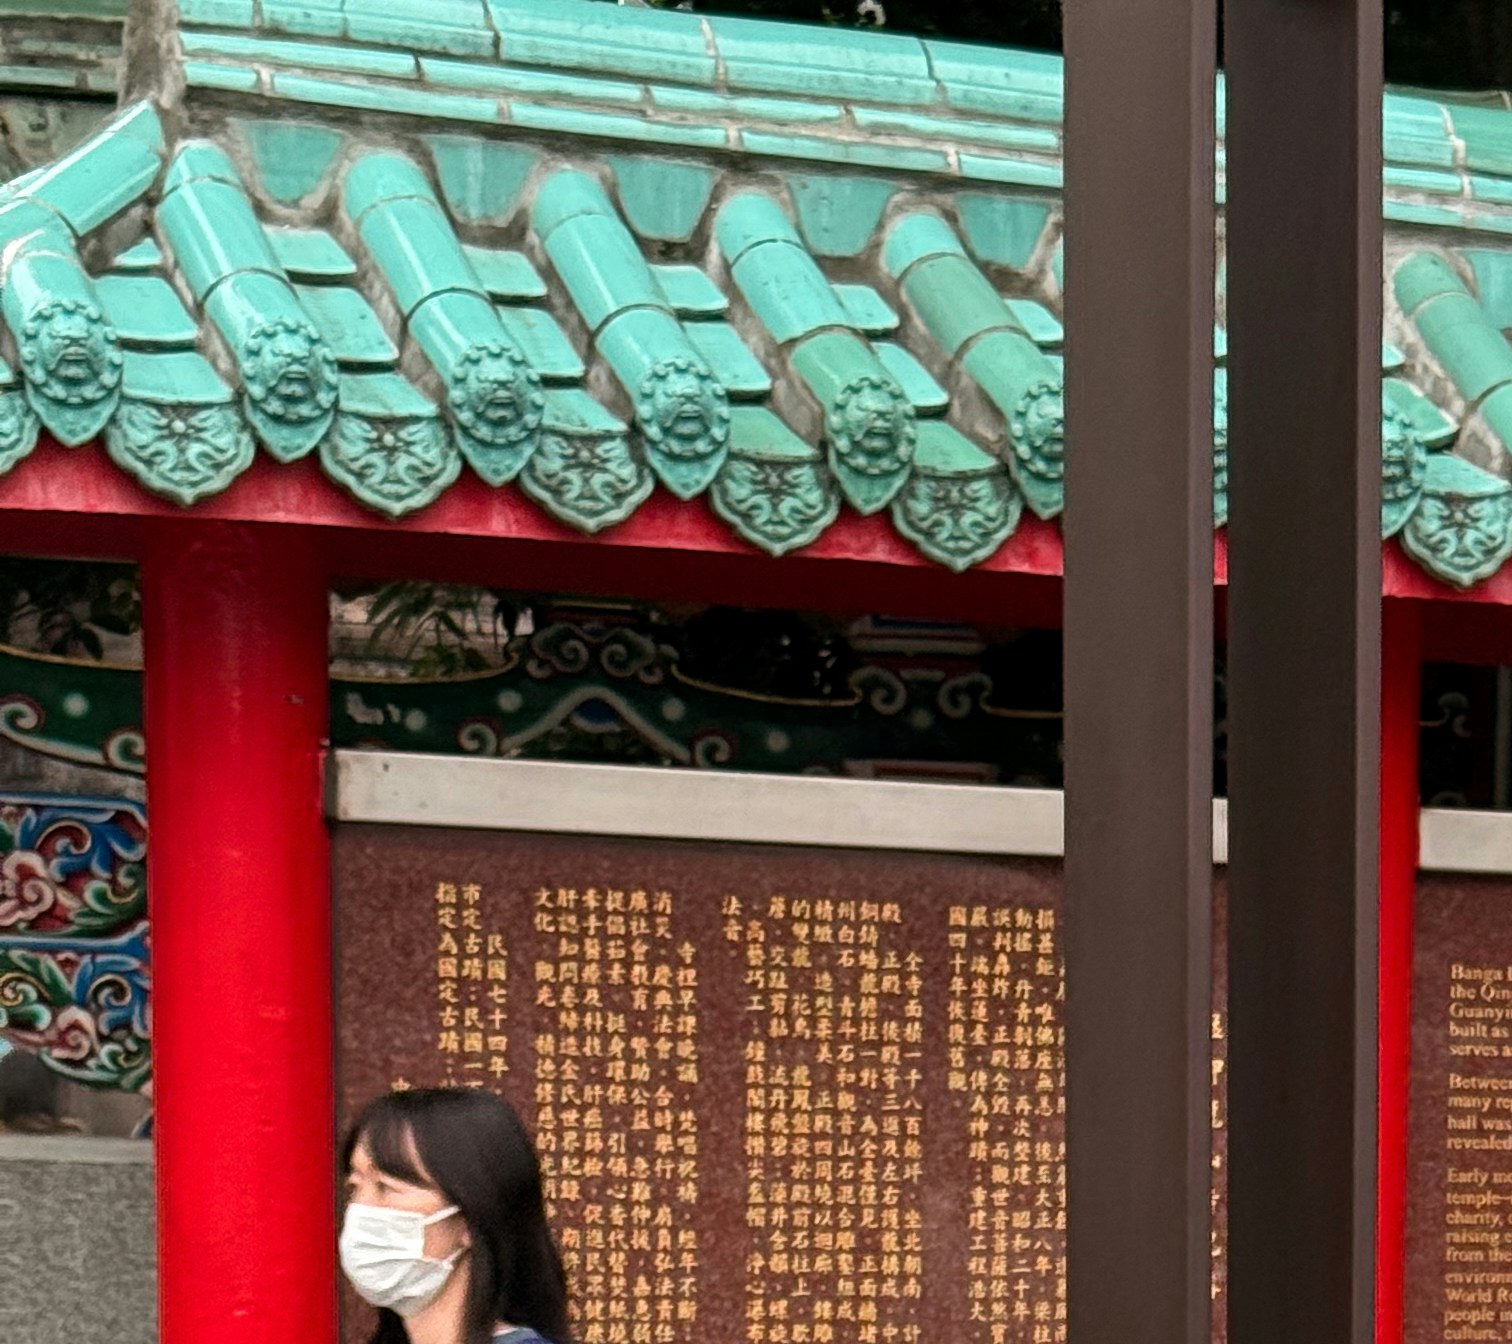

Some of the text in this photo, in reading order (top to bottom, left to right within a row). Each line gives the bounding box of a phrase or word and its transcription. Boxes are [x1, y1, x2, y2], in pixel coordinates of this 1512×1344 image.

[1450, 983, 1474, 999] the
[1449, 1021, 1487, 1037] built
[1449, 1045, 1498, 1056] serves
[1448, 1097, 1491, 1112] many
[1447, 1114, 1476, 1129] hall
[1482, 1119, 1512, 1130] was
[1446, 1133, 1512, 1149] revealed
[1447, 1167, 1488, 1187] Early
[1445, 1227, 1499, 1247] raising
[1446, 1247, 1483, 1262] from
[1488, 1247, 1512, 1262] the
[1445, 1287, 1492, 1302] World
[1444, 1306, 1494, 1324] people
